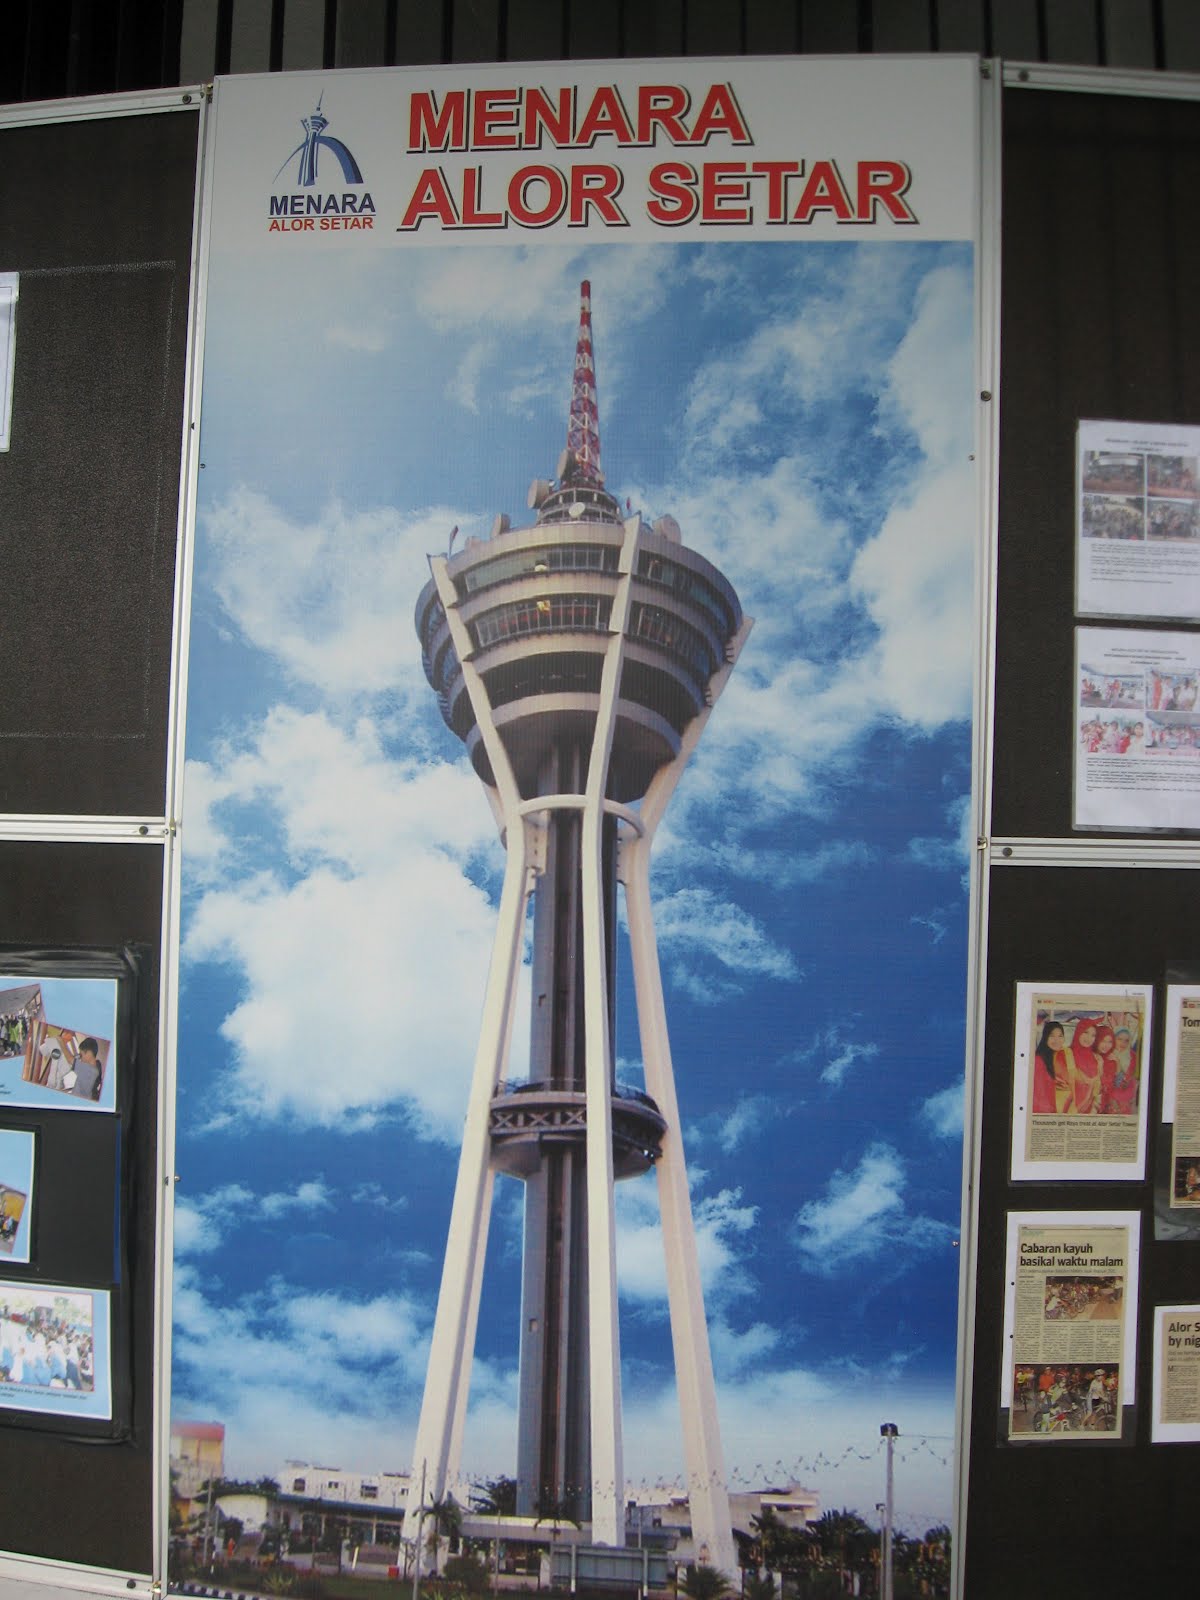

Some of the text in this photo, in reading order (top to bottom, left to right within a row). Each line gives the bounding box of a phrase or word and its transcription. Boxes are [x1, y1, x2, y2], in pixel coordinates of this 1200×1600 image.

[406, 83, 755, 154] MENARA
[396, 158, 920, 232] ALOR SETAR
[269, 192, 376, 216] MENARA
[268, 216, 374, 232] ALOR SETAR
[1020, 1243, 1093, 1255] Cabaran kayuh
[1020, 1256, 1123, 1267] basikal waktu malam
[1168, 1321, 1192, 1333] Alor
[1168, 1335, 1182, 1348] by
